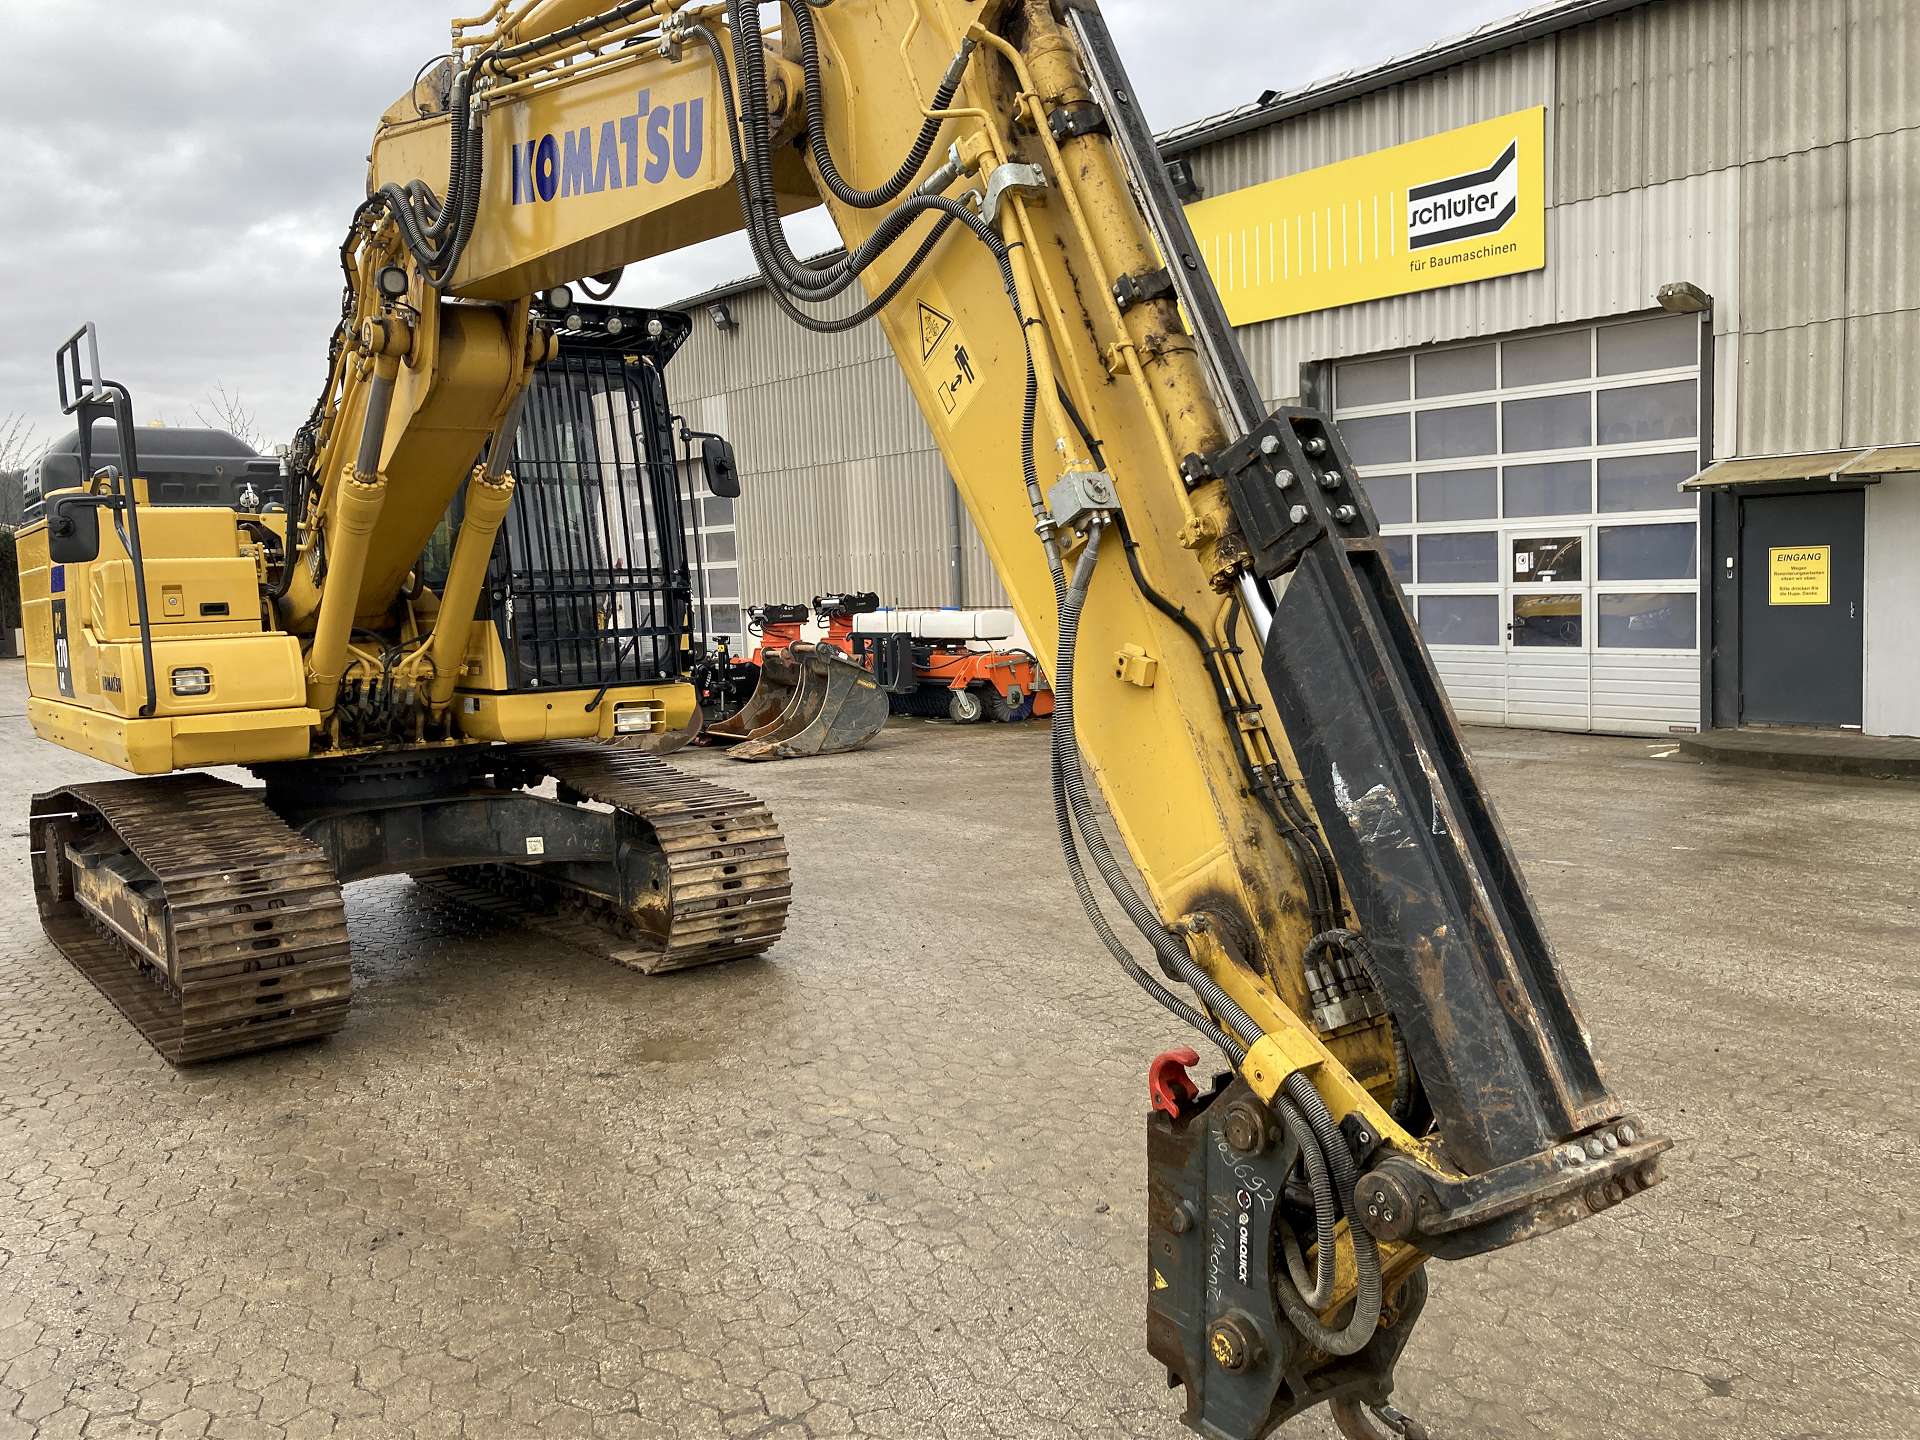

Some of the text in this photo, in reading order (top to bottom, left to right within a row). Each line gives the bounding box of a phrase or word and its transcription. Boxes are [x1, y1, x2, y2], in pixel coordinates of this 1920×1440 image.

[512, 88, 703, 205] KOMATSU
[1409, 191, 1498, 228] schlüter
[1410, 242, 1517, 272] für Baumaschinen
[1777, 552, 1822, 562] EINGANG
[102, 673, 122, 694] KOMATSU
[1238, 1226, 1250, 1285] OILQUICK
